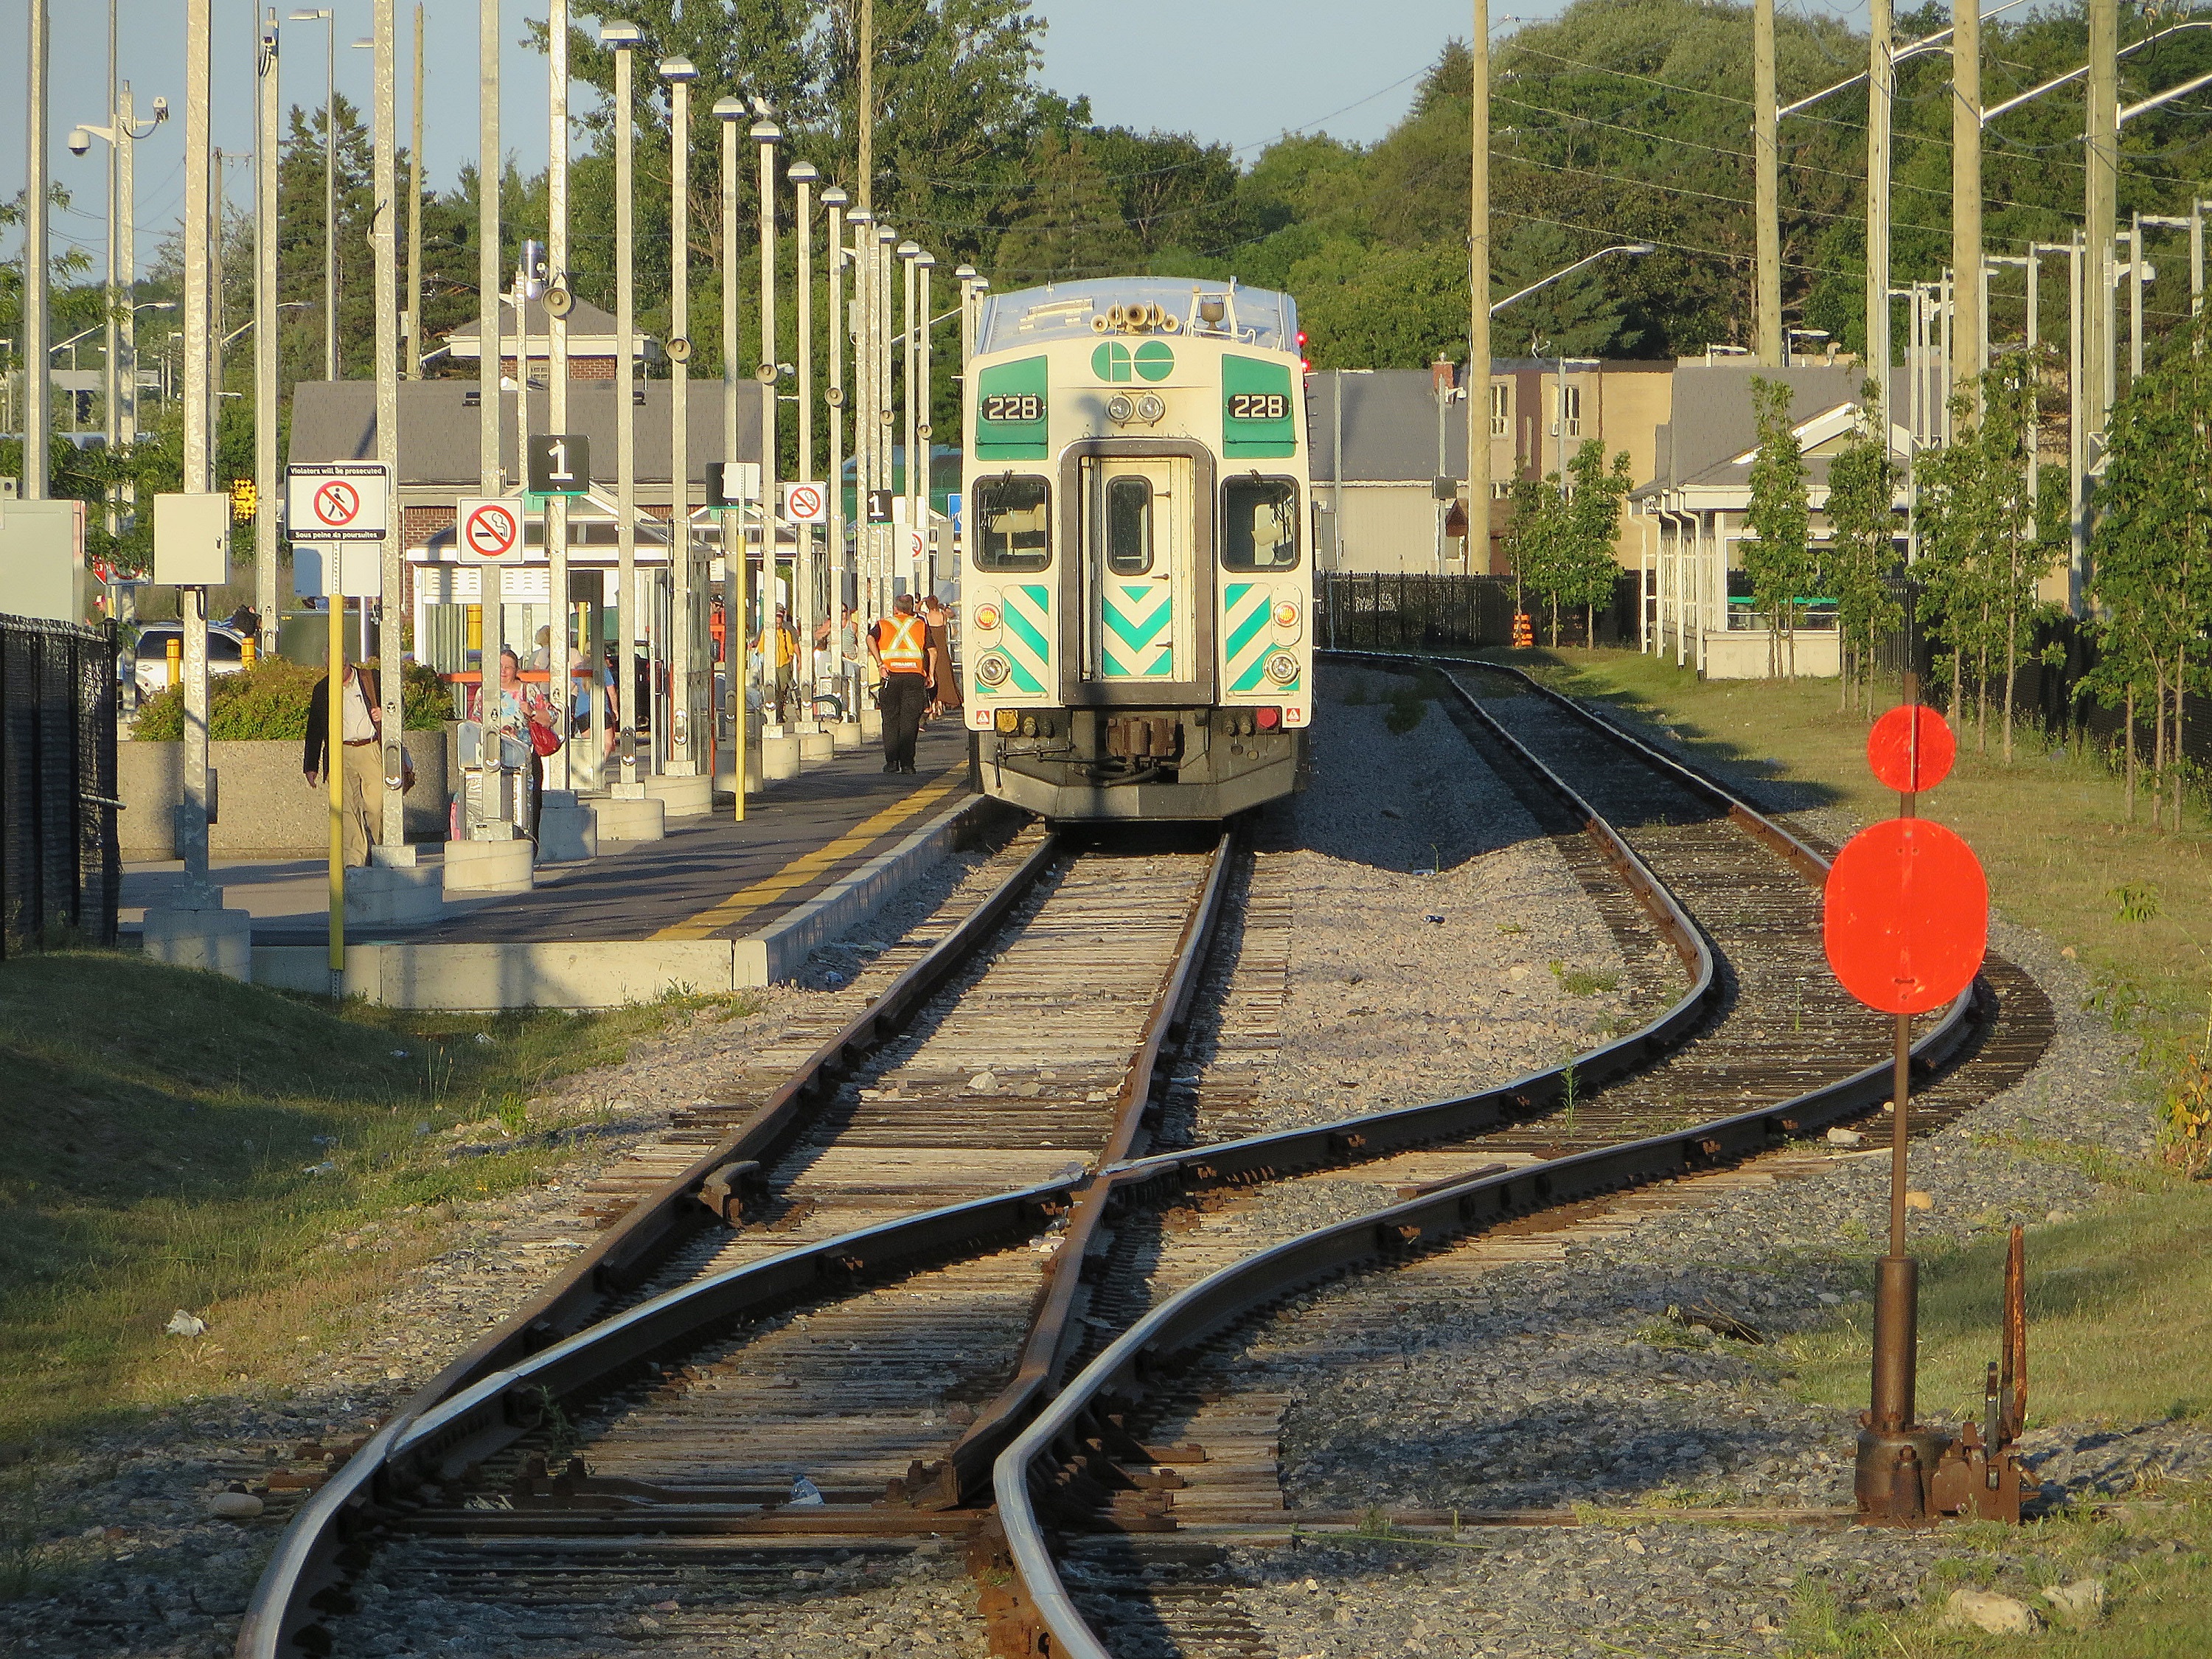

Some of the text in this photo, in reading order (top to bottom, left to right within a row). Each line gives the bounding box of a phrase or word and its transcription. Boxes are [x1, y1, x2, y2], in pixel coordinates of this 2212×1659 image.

[1091, 340, 1175, 383] GO
[989, 397, 1037, 420] 228
[1234, 395, 1283, 418] 228
[345, 467, 382, 476] prosecuted
[548, 444, 574, 480] 1
[868, 495, 885, 517] 1
